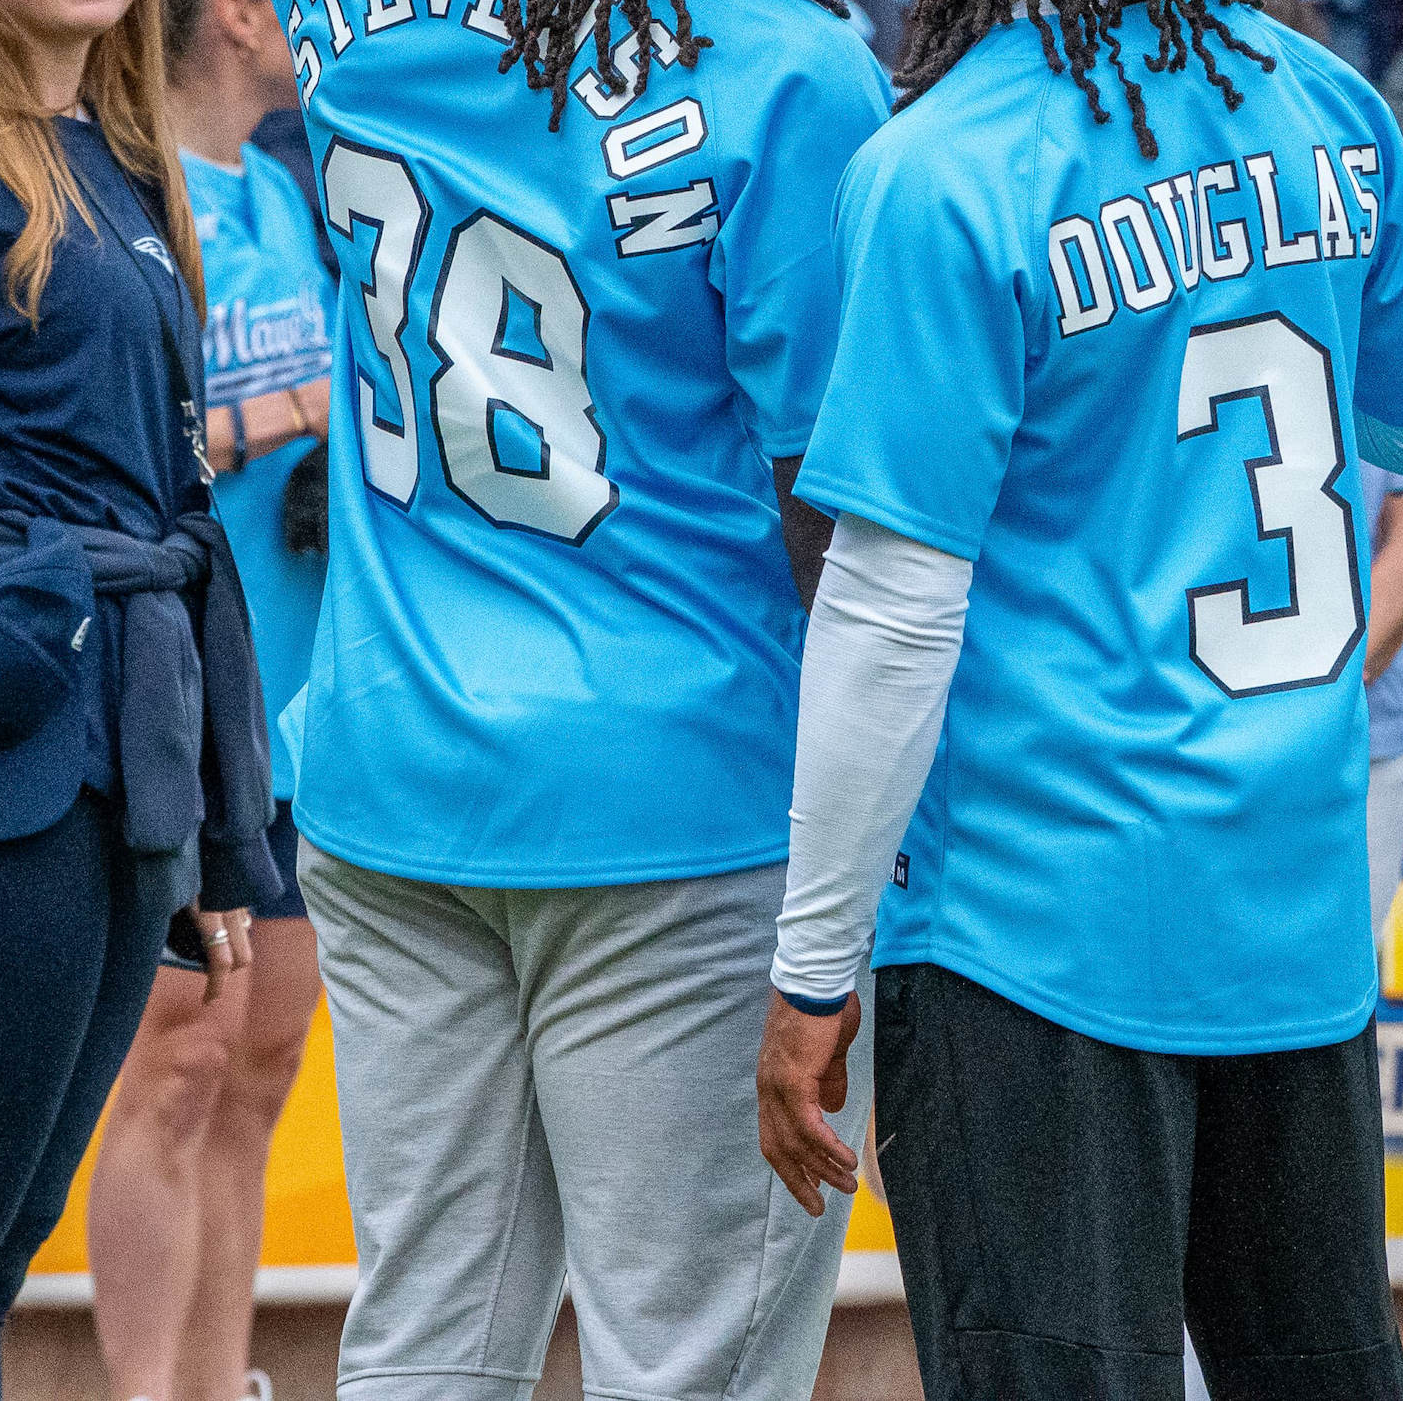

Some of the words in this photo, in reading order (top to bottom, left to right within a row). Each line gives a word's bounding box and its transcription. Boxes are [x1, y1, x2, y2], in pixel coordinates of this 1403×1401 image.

[322, 134, 620, 549] 38
[1048, 143, 1380, 339] DOUGLAS
[1176, 310, 1367, 700] 3
